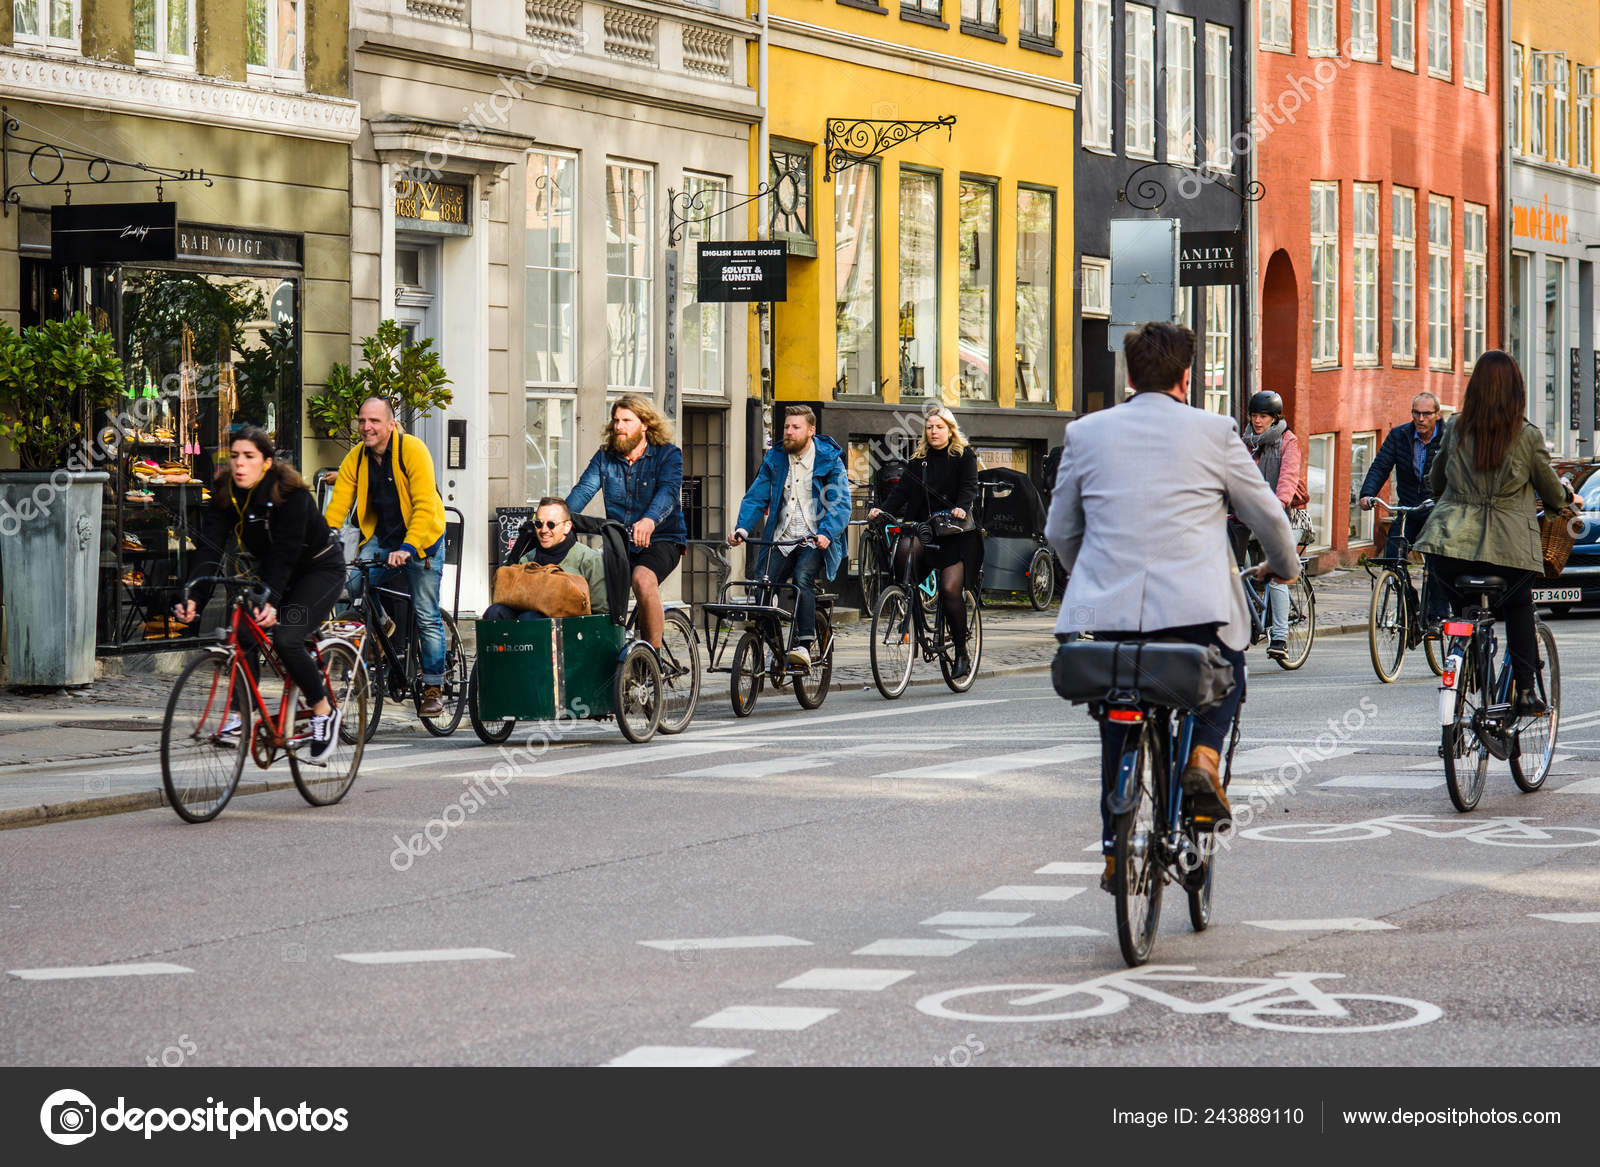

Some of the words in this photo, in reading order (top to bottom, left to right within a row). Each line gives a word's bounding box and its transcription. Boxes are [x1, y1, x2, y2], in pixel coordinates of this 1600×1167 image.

[1512, 192, 1568, 245] mother
[181, 234, 209, 251] RAH
[218, 237, 263, 255] VOIGT
[1181, 247, 1234, 260] ANITY
[721, 266, 752, 274] SØLVET
[754, 266, 762, 274] &
[721, 274, 763, 282] KUNSTEN
[1547, 591, 1559, 600] 34
[1561, 590, 1580, 600] 090
